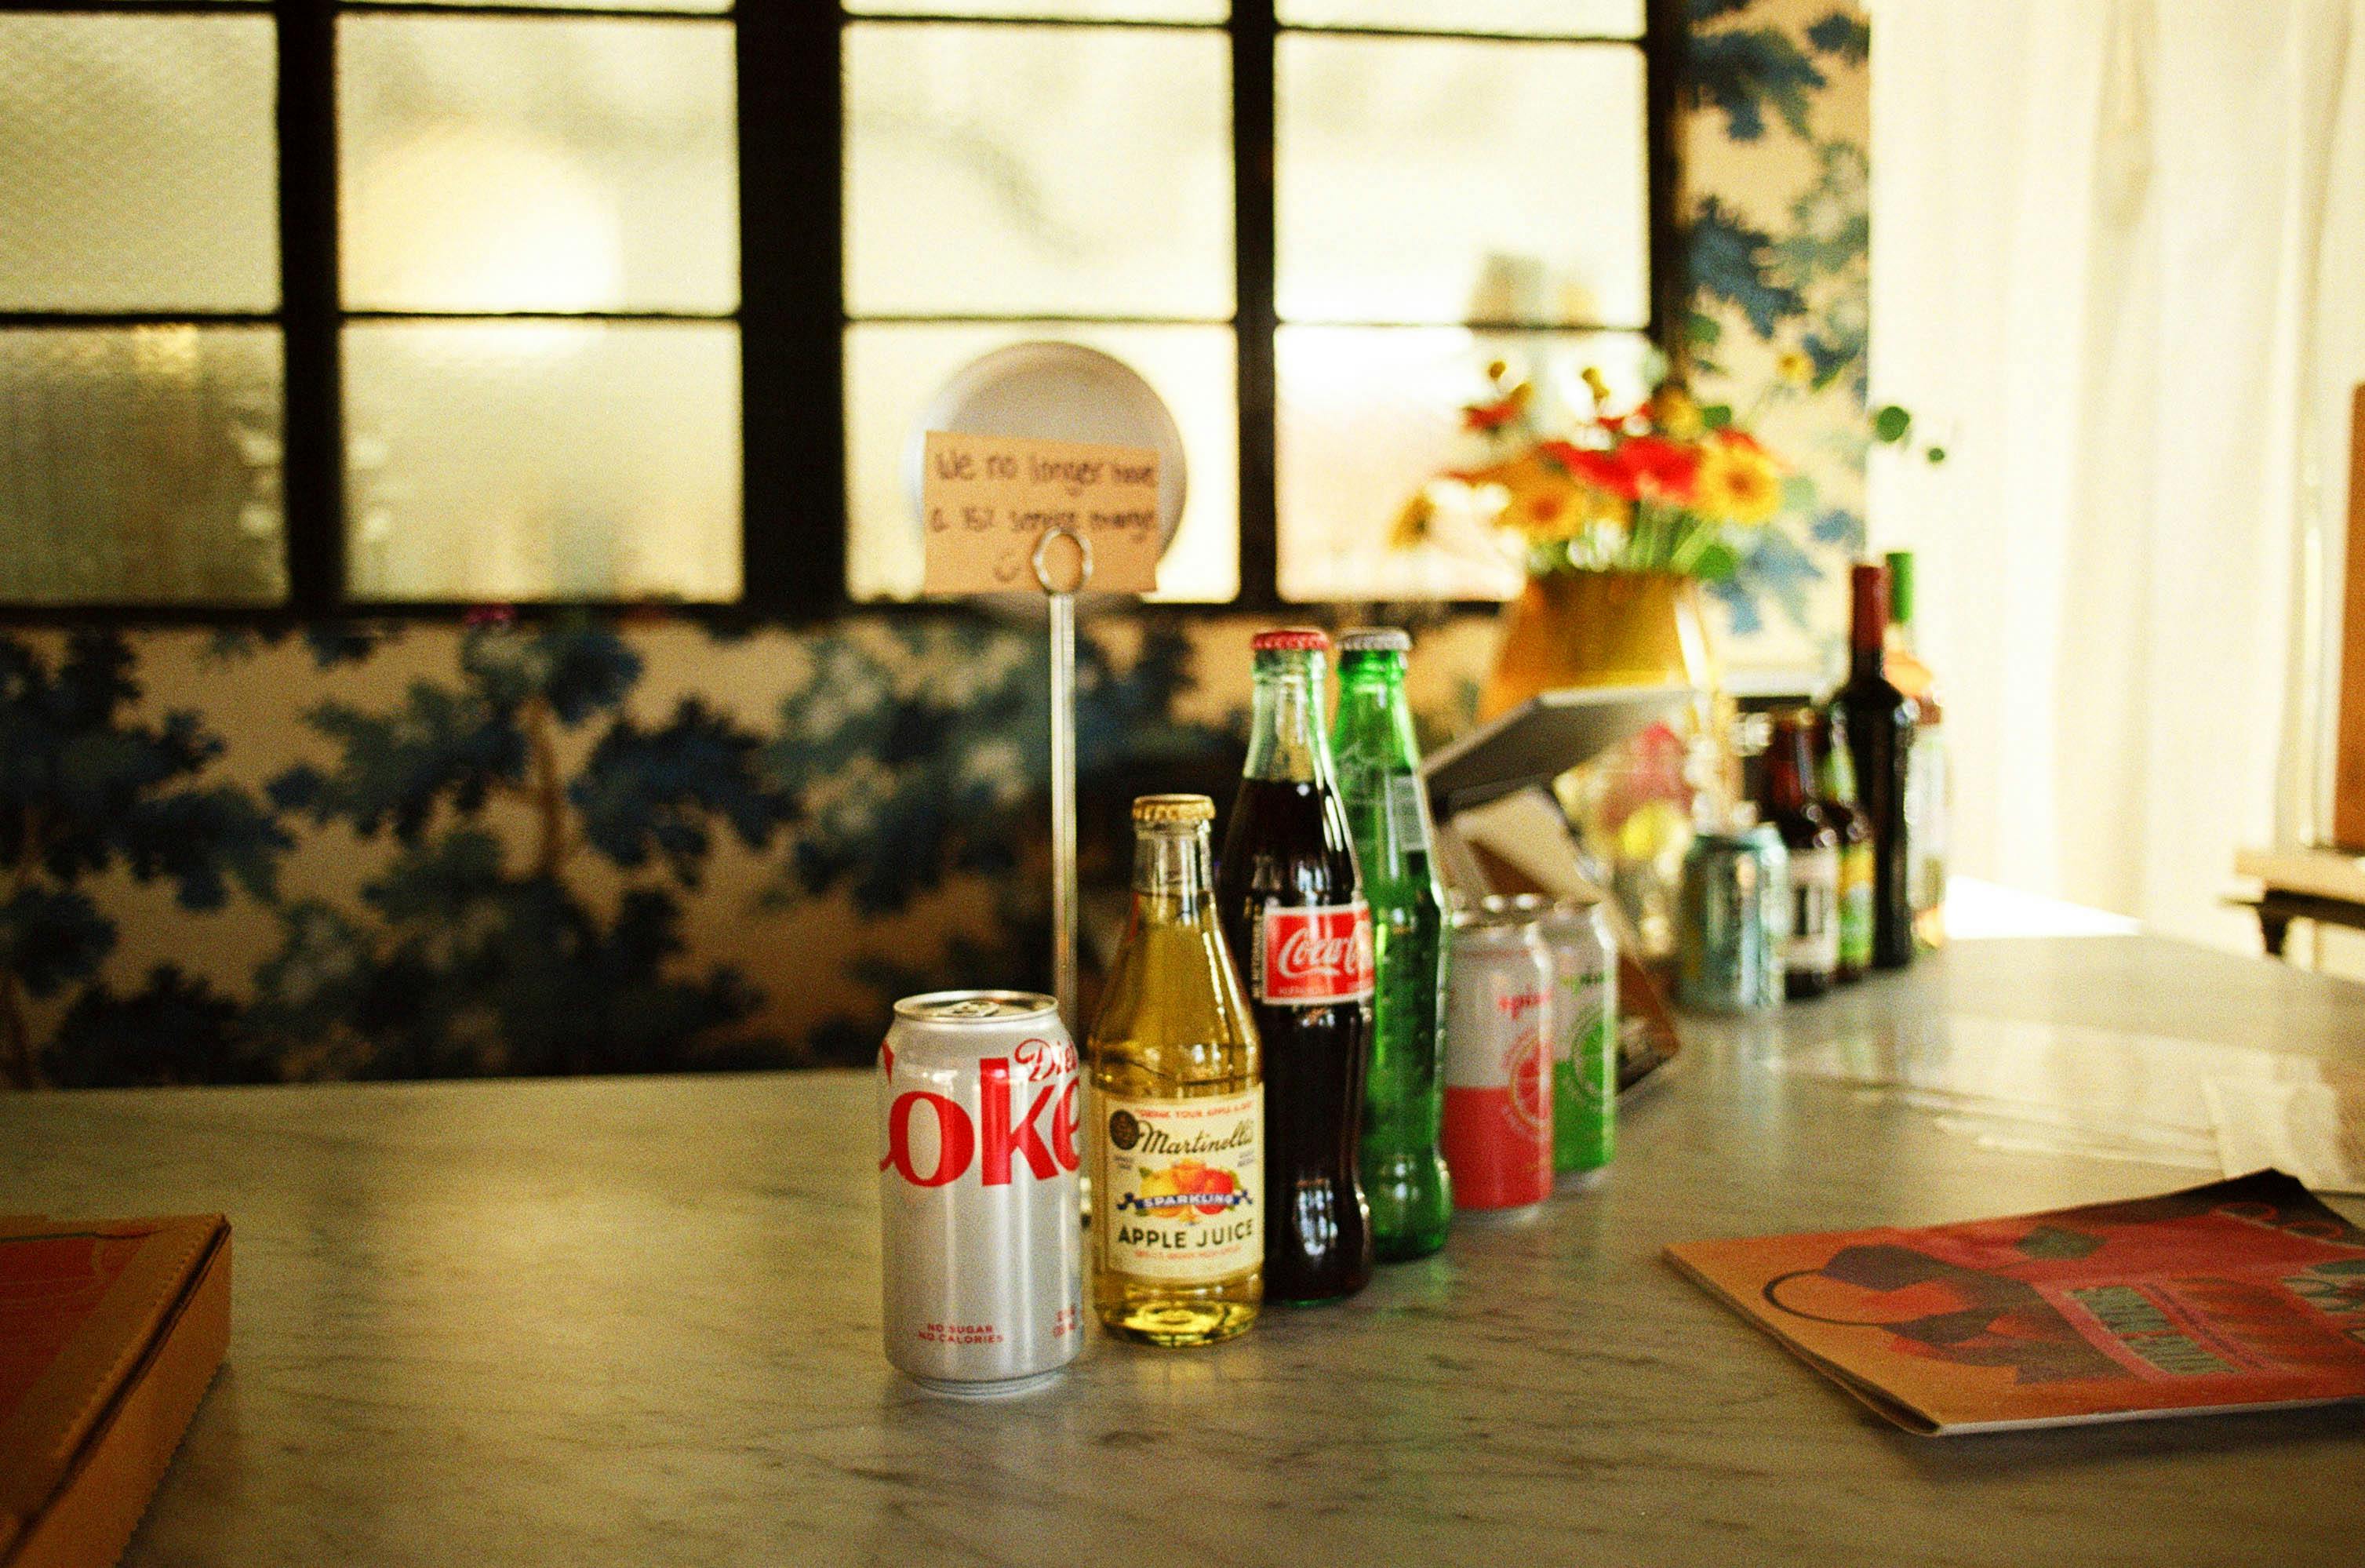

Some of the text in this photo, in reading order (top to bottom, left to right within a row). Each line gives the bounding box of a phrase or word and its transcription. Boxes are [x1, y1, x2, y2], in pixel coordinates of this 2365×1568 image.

[934, 449, 977, 481] We
[985, 453, 1018, 480] no
[1028, 453, 1104, 497] longer
[879, 1039, 1080, 1188] oke
[1142, 1192, 1234, 1209] SPARKLING
[1118, 1219, 1253, 1249] APPLE JUICE
[918, 1330, 1004, 1344] NO CALORIES
[927, 1323, 993, 1333] NO SUGAR
